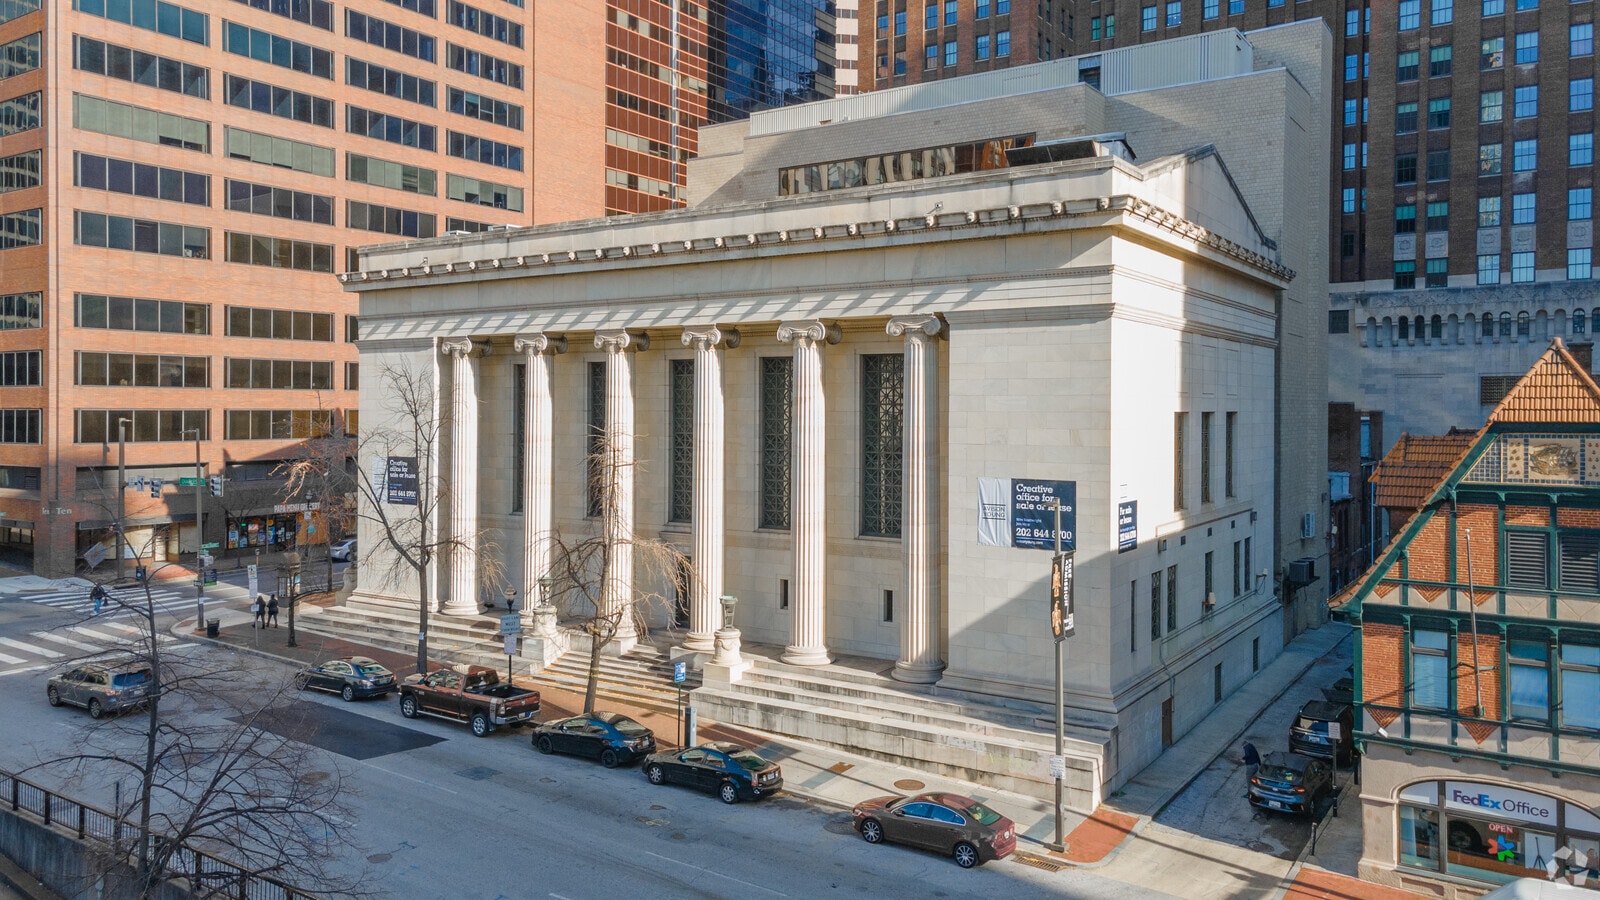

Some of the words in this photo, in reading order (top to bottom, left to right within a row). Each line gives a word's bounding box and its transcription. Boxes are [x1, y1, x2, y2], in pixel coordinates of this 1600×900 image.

[1016, 484, 1053, 493] Creative
[1016, 493, 1040, 501] office
[1042, 494, 1055, 502] for
[1048, 504, 1072, 512] lese
[1016, 528, 1031, 537] 202
[1034, 529, 1049, 538] 644
[1052, 530, 1072, 539] 800
[1453, 790, 1501, 810] FedEx
[1503, 800, 1549, 818] Office
[1489, 823, 1514, 833] OPEN
